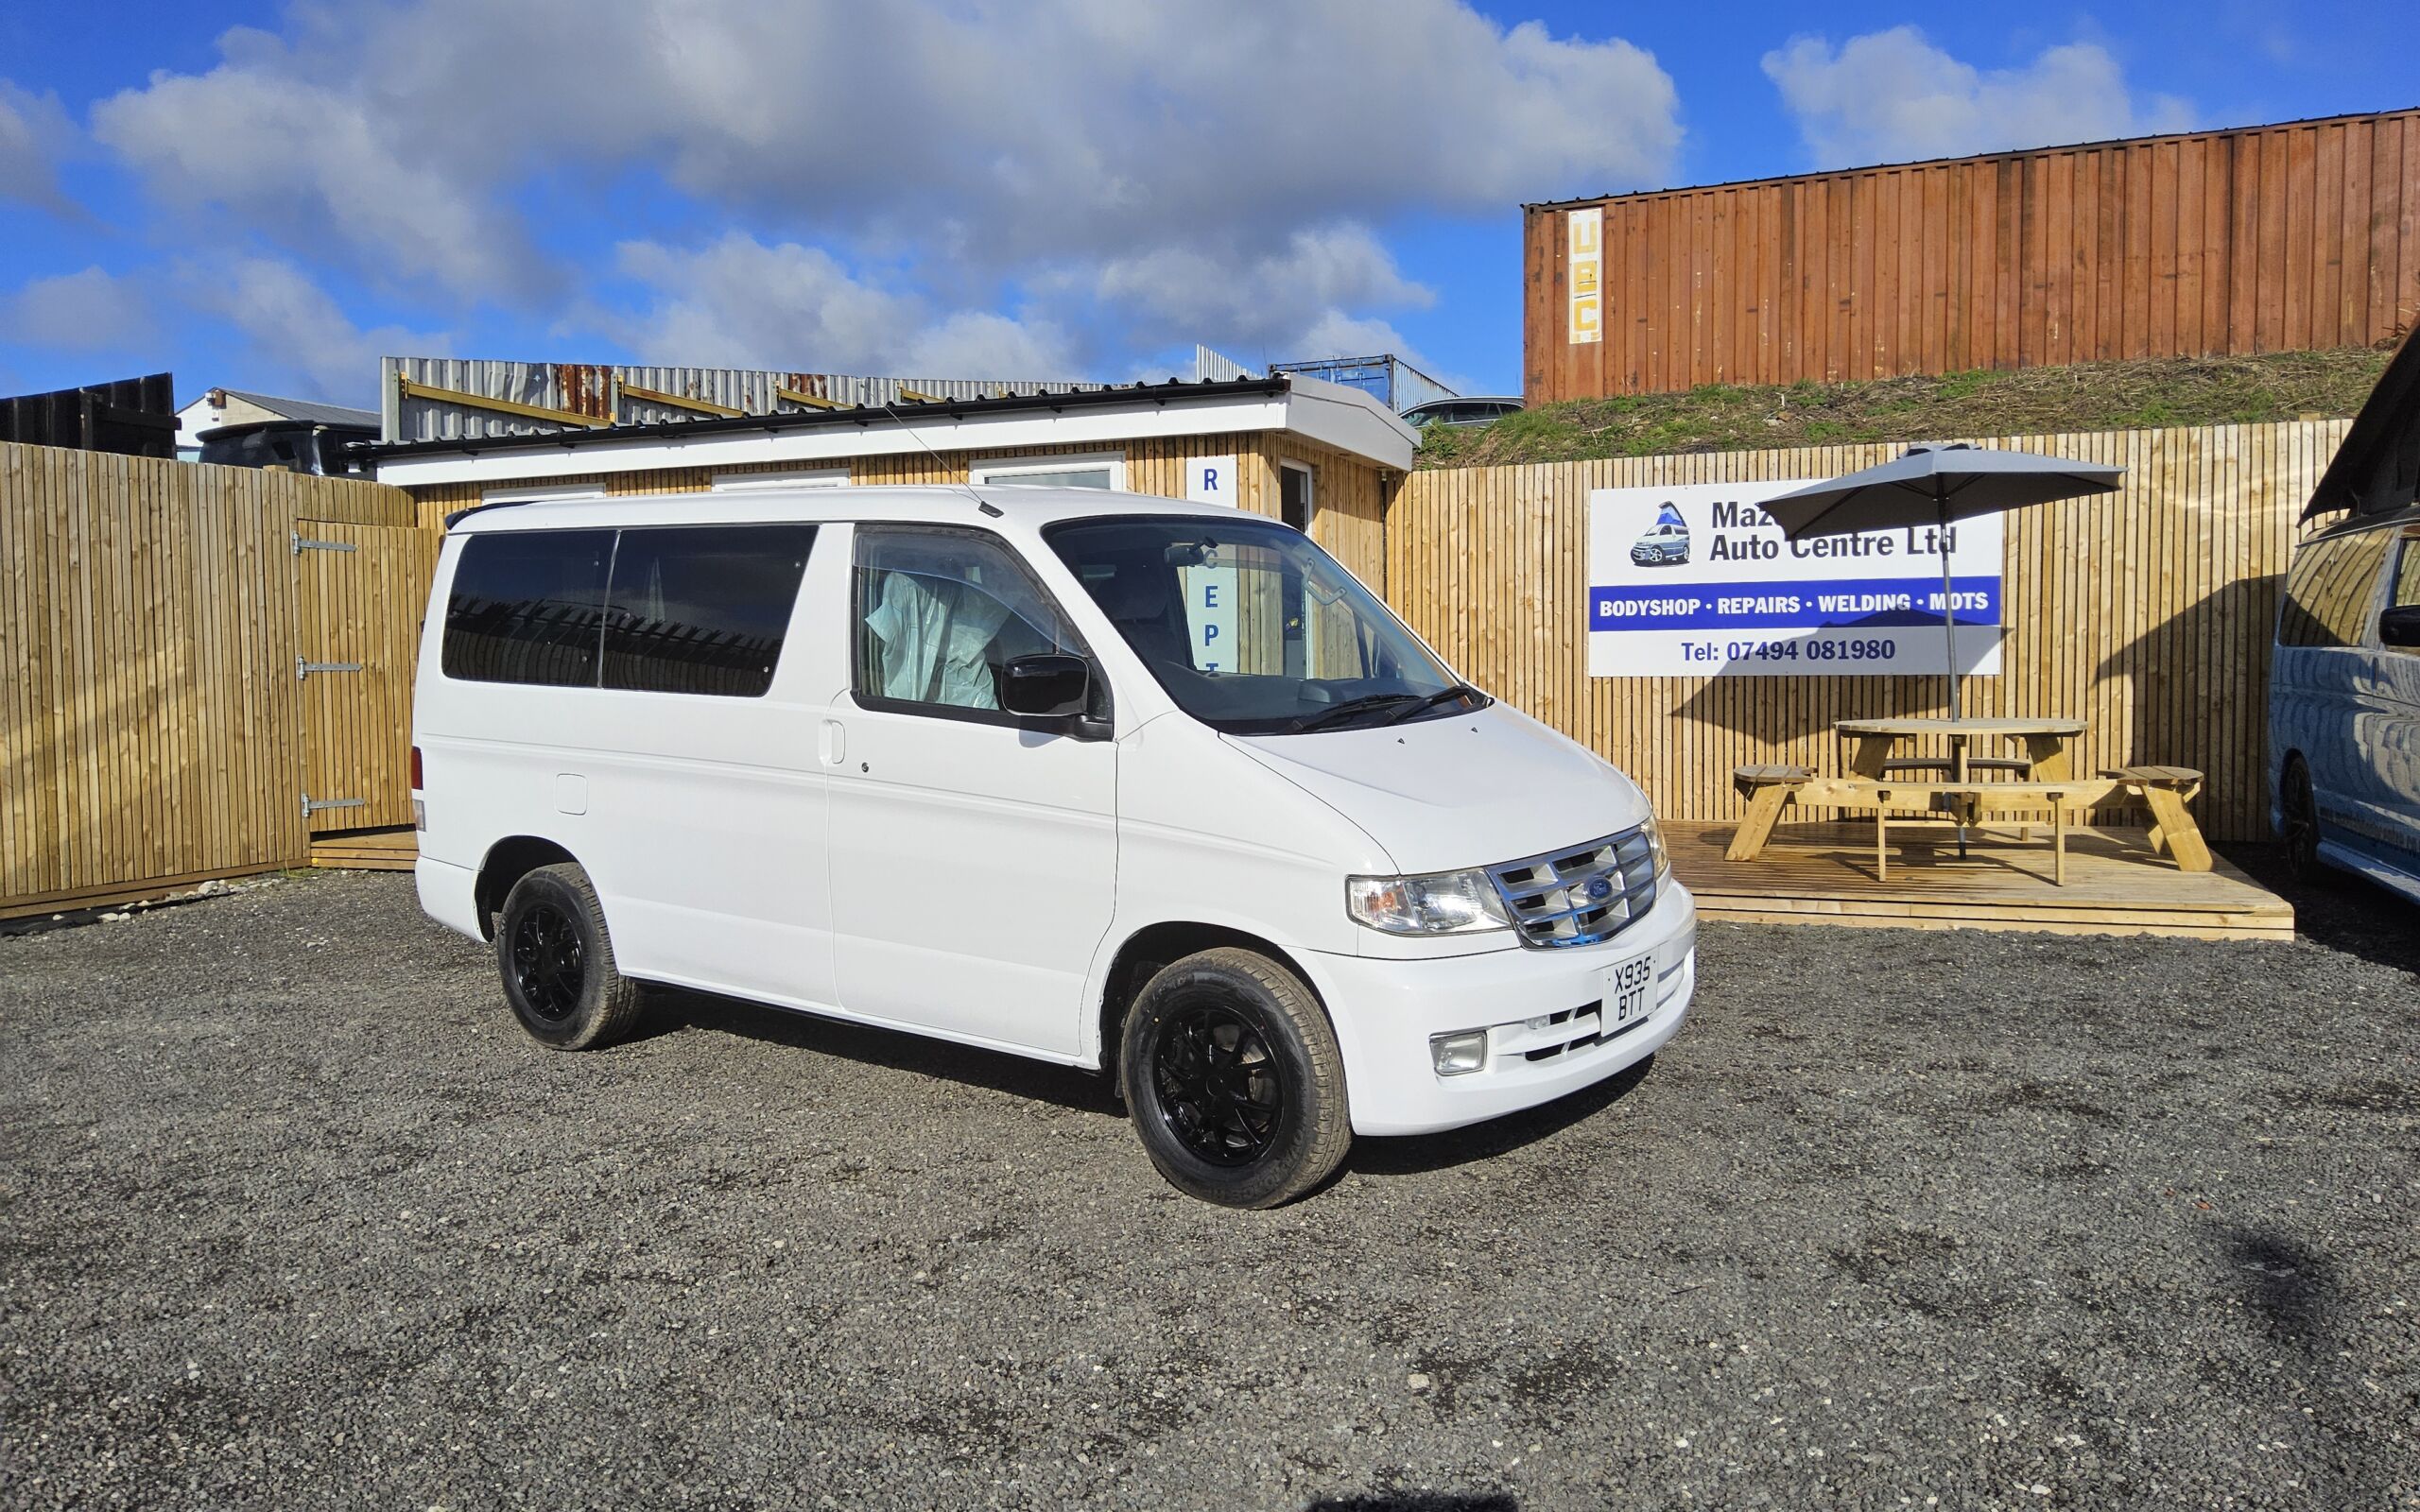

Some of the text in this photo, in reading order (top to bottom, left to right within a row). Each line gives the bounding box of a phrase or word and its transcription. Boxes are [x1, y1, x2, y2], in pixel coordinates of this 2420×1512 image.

[1711, 501, 1773, 528] Maz
[1709, 526, 1957, 561] Auto Centre Ltd
[1599, 592, 1989, 617] BODYSHOP REPAIRS WELDING MOTS
[1681, 639, 1895, 662] Tel: 07494 081980
[1615, 955, 1651, 994] X935
[1618, 986, 1645, 1021] BTT
